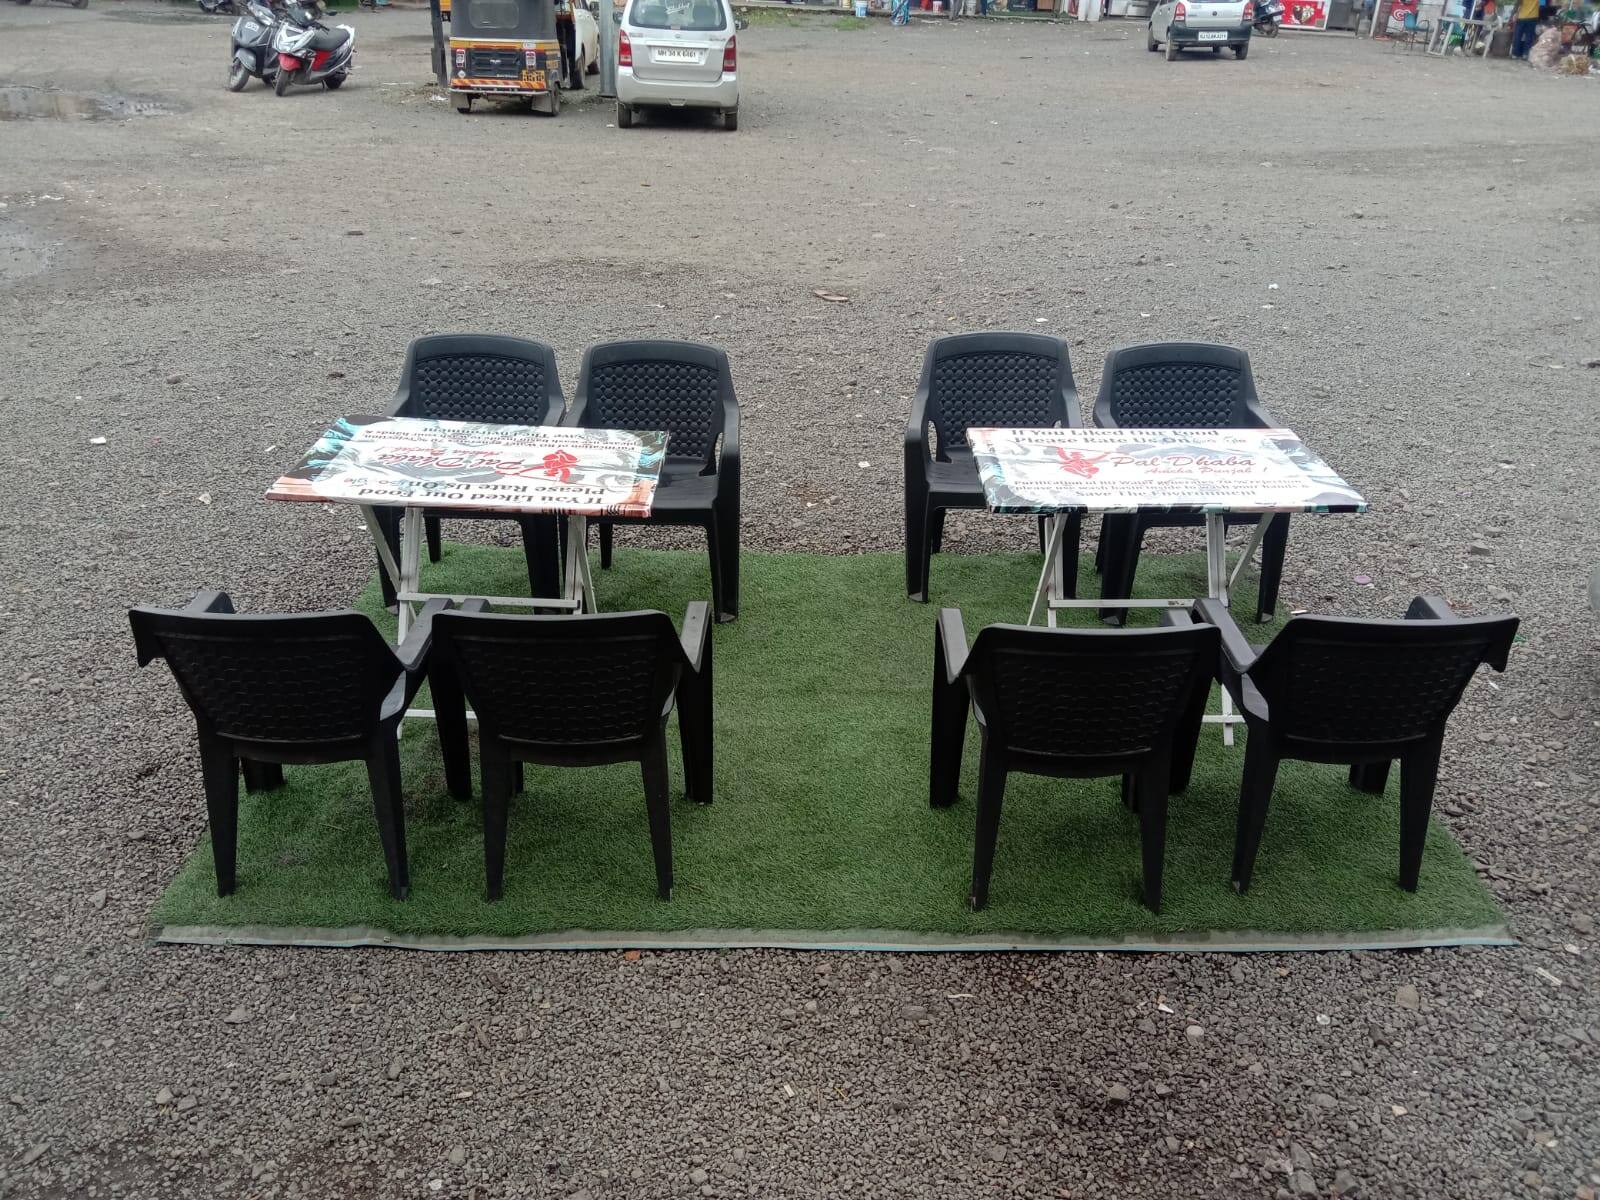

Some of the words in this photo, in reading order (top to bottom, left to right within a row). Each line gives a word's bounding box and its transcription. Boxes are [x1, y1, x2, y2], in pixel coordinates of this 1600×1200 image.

[423, 428, 518, 436] Environment
[377, 455, 464, 468] Dhaba
[470, 458, 525, 470] Pal
[1110, 456, 1160, 467] Pal
[1167, 456, 1256, 466] Dhaba
[408, 481, 439, 489] On
[446, 482, 471, 490] Us
[478, 484, 528, 492] Rate
[358, 488, 414, 498] Food
[535, 486, 606, 495] Please
[420, 491, 464, 500] Our
[469, 493, 534, 502] Liked
[541, 496, 581, 504] You
